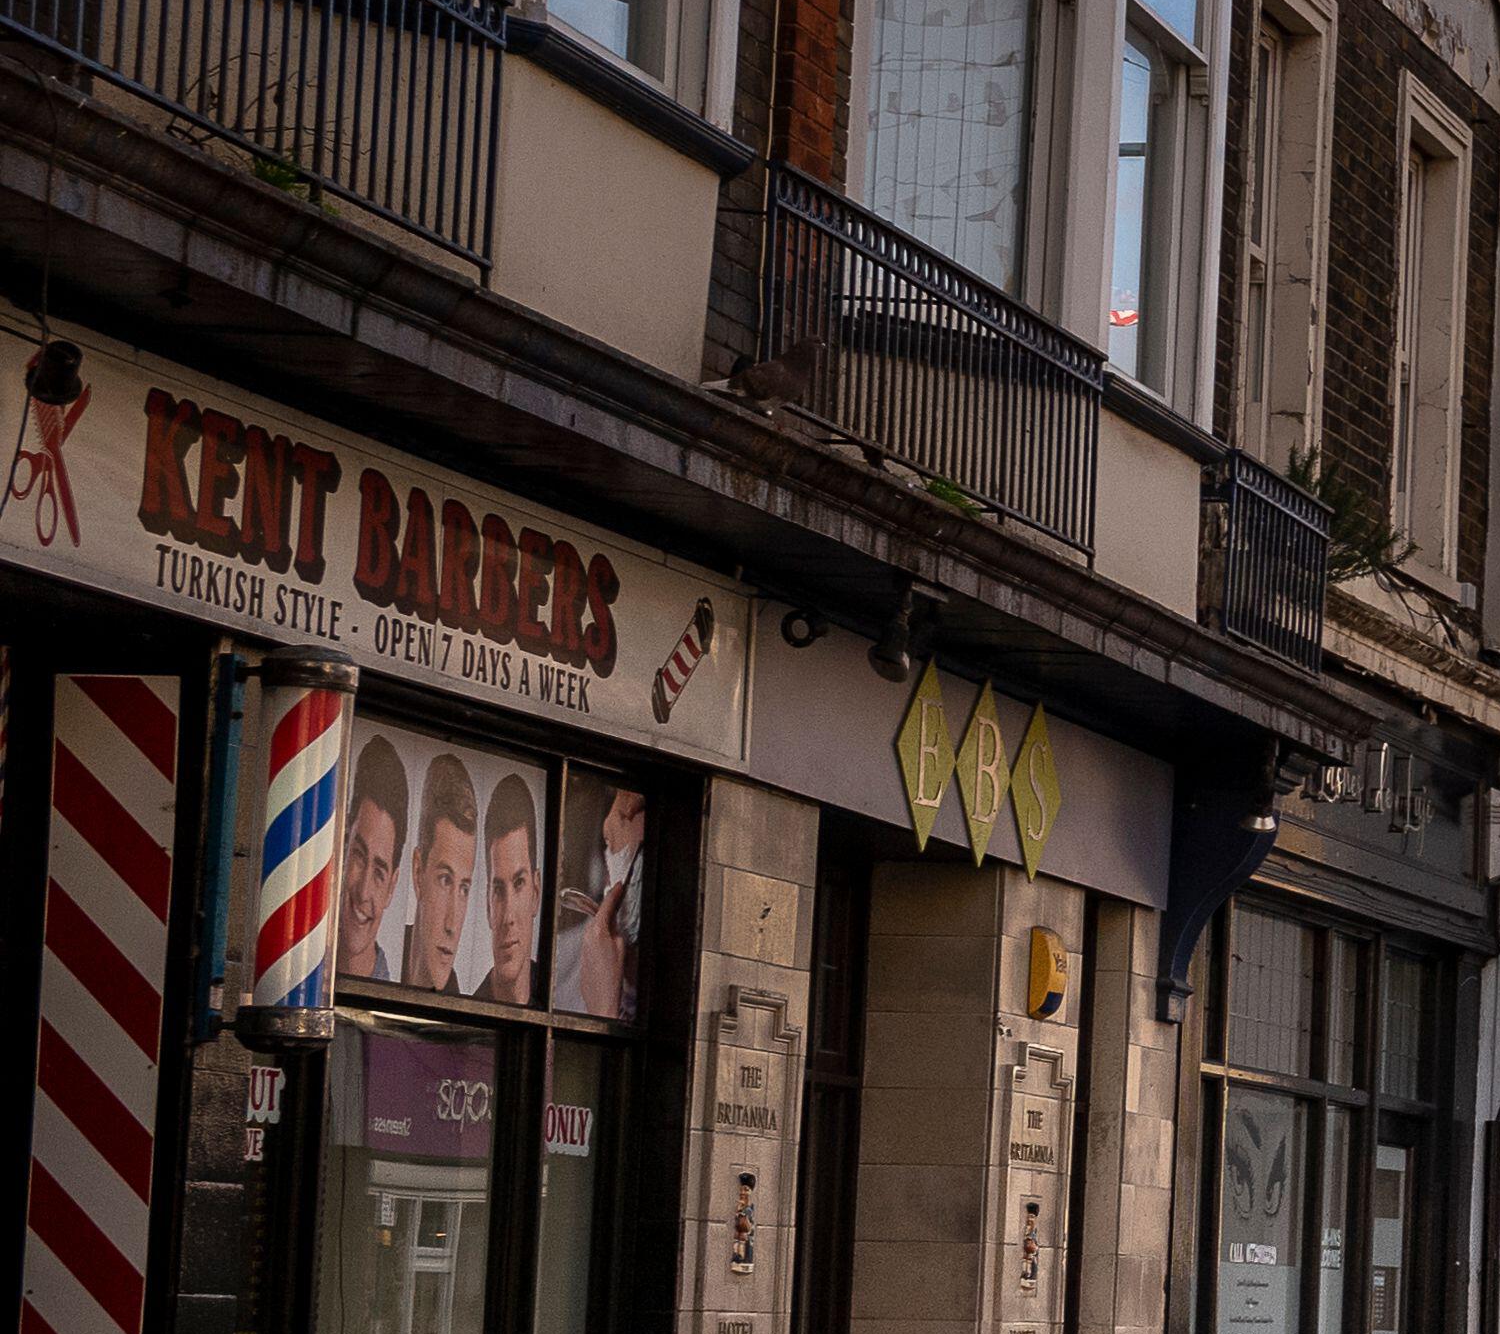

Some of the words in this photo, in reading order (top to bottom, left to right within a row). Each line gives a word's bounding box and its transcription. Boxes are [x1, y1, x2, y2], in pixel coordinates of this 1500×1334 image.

[138, 387, 342, 585] KENT
[353, 467, 621, 679] BARBERS
[155, 543, 266, 619] TURKISH
[273, 583, 343, 642] STYLE
[374, 613, 432, 668] OPEN
[441, 634, 453, 672] 7
[461, 639, 512, 691] DAYS
[518, 657, 531, 697] A
[538, 663, 591, 714] WEEK
[740, 1066, 762, 1090] THE
[544, 1103, 592, 1154] ONLY
[716, 1102, 777, 1131] BRITANNIA
[1026, 1110, 1043, 1131] THE
[1010, 1142, 1055, 1165] BRITANNIA
